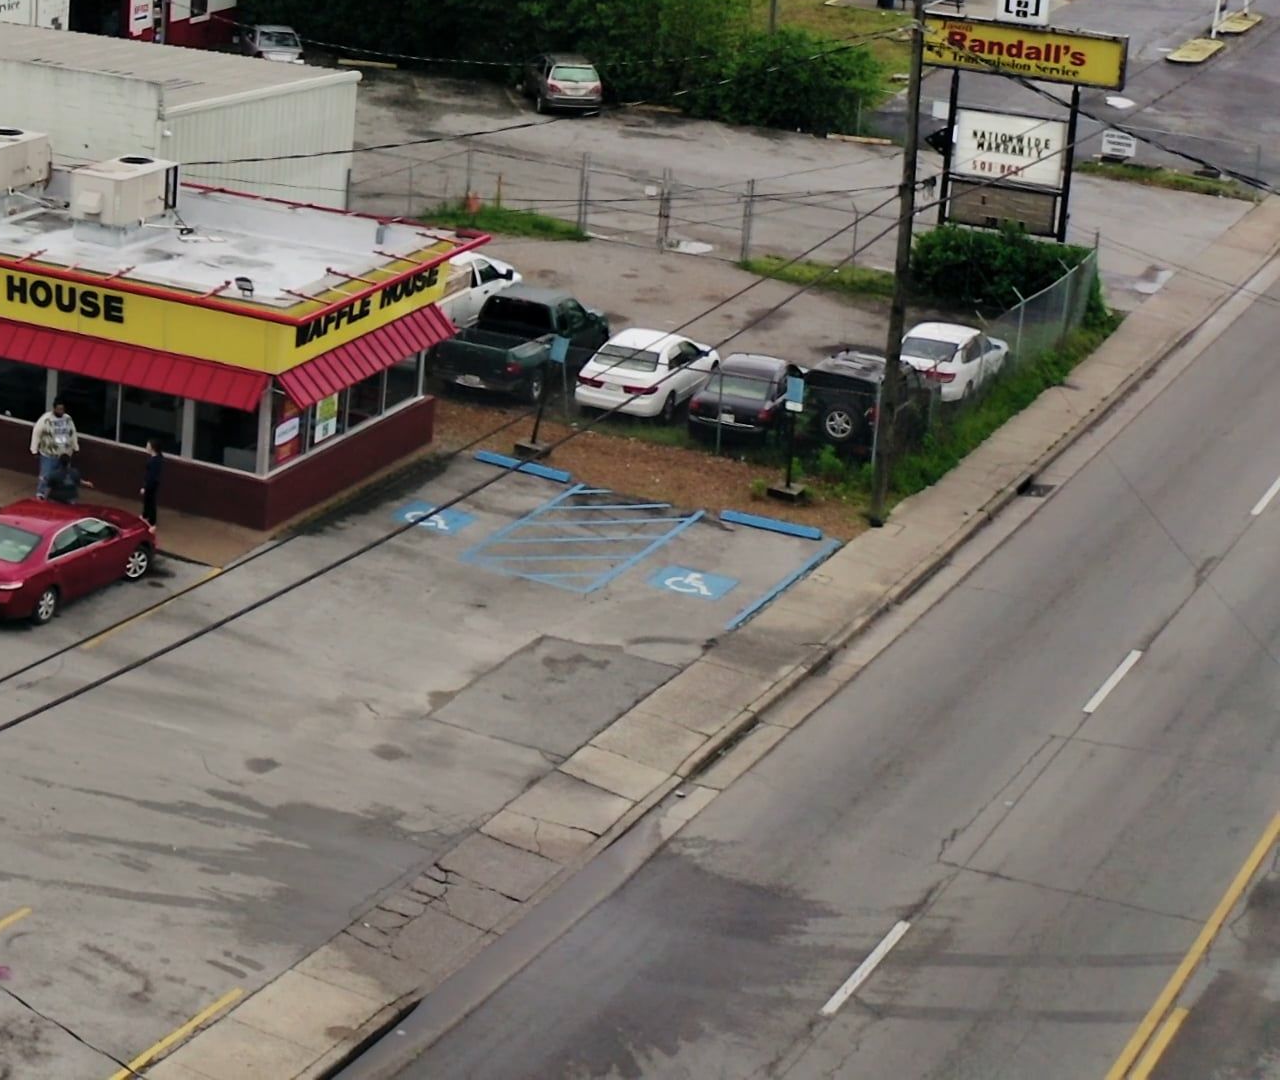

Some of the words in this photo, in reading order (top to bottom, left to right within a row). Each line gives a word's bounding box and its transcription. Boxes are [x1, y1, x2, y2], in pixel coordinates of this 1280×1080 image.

[948, 30, 1086, 67] Randall's
[972, 130, 1050, 150] NATIONWIDE
[977, 140, 1042, 159] WARRANTY
[6, 275, 125, 324] HOUSE
[380, 269, 439, 310] HOUSE
